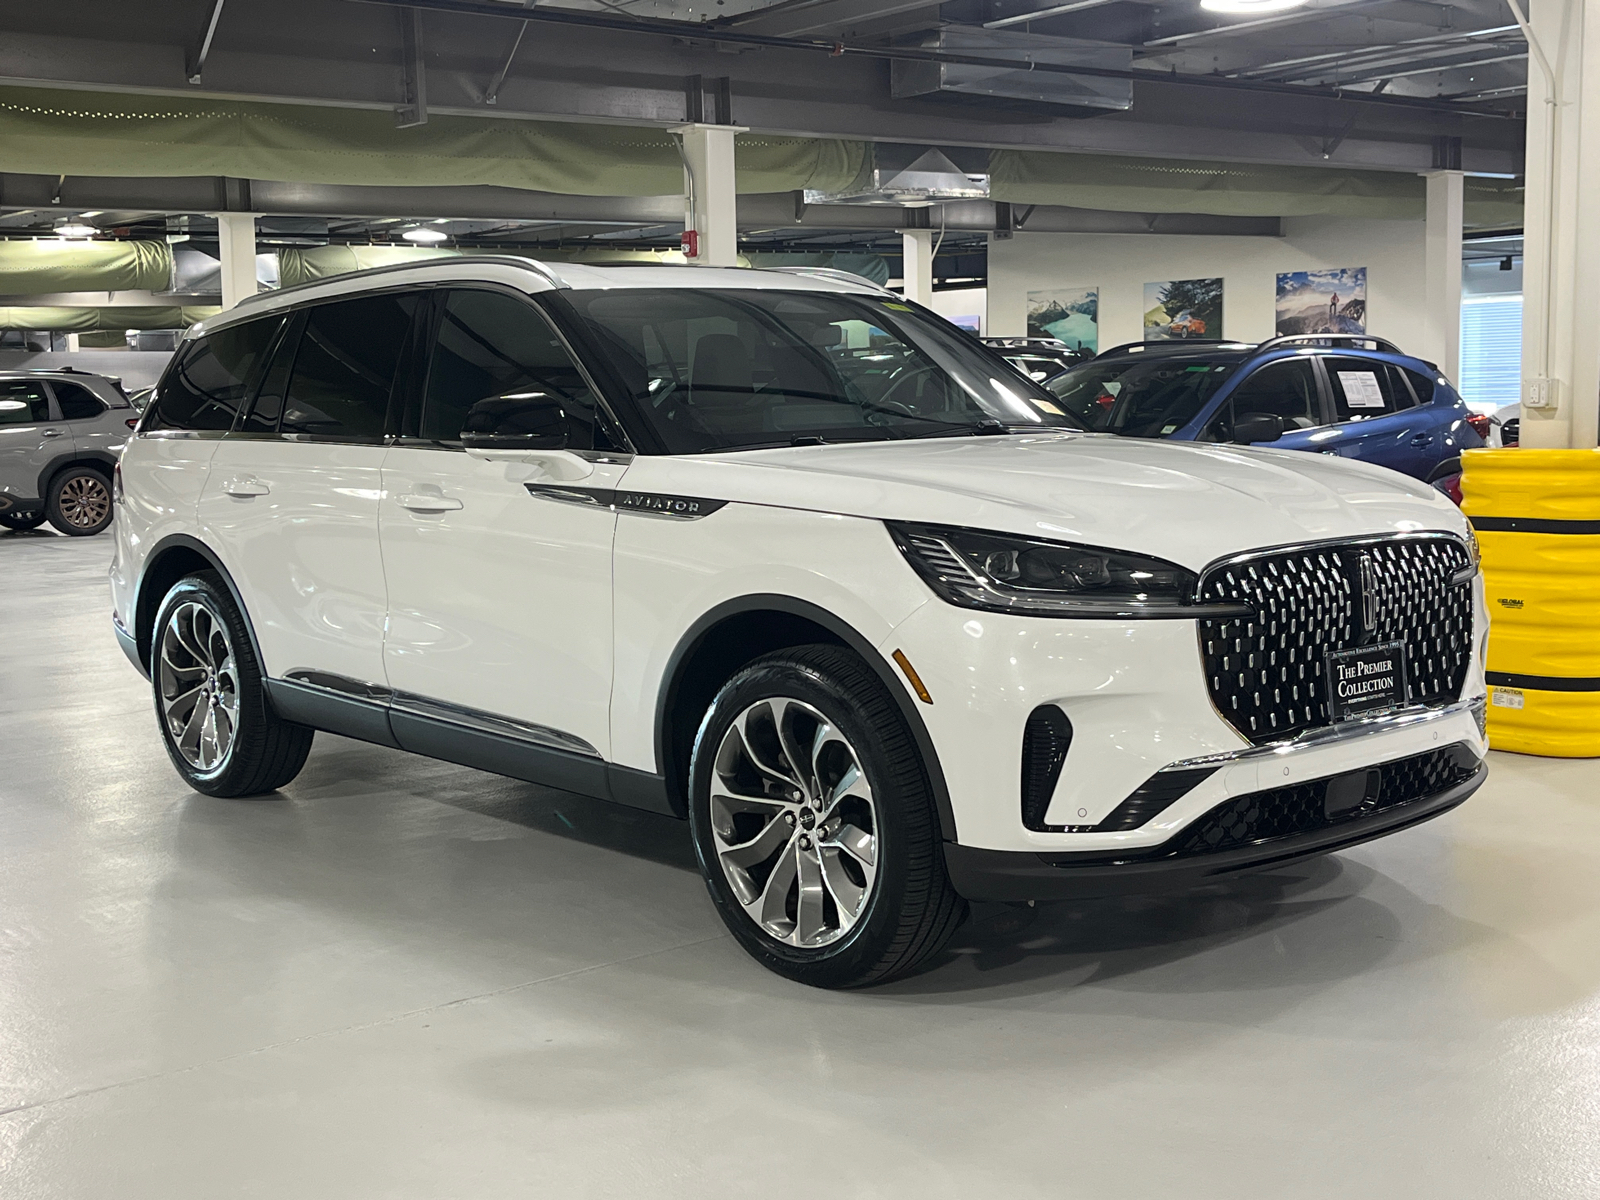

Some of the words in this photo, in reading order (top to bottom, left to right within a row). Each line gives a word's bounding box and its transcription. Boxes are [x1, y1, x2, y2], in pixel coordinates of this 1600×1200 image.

[623, 495, 699, 511] AVIATOR
[1337, 664, 1356, 680] THE
[1357, 660, 1393, 677] PREMIER
[1338, 676, 1393, 697] COLLECTION
[1500, 687, 1523, 696] CAUTION
